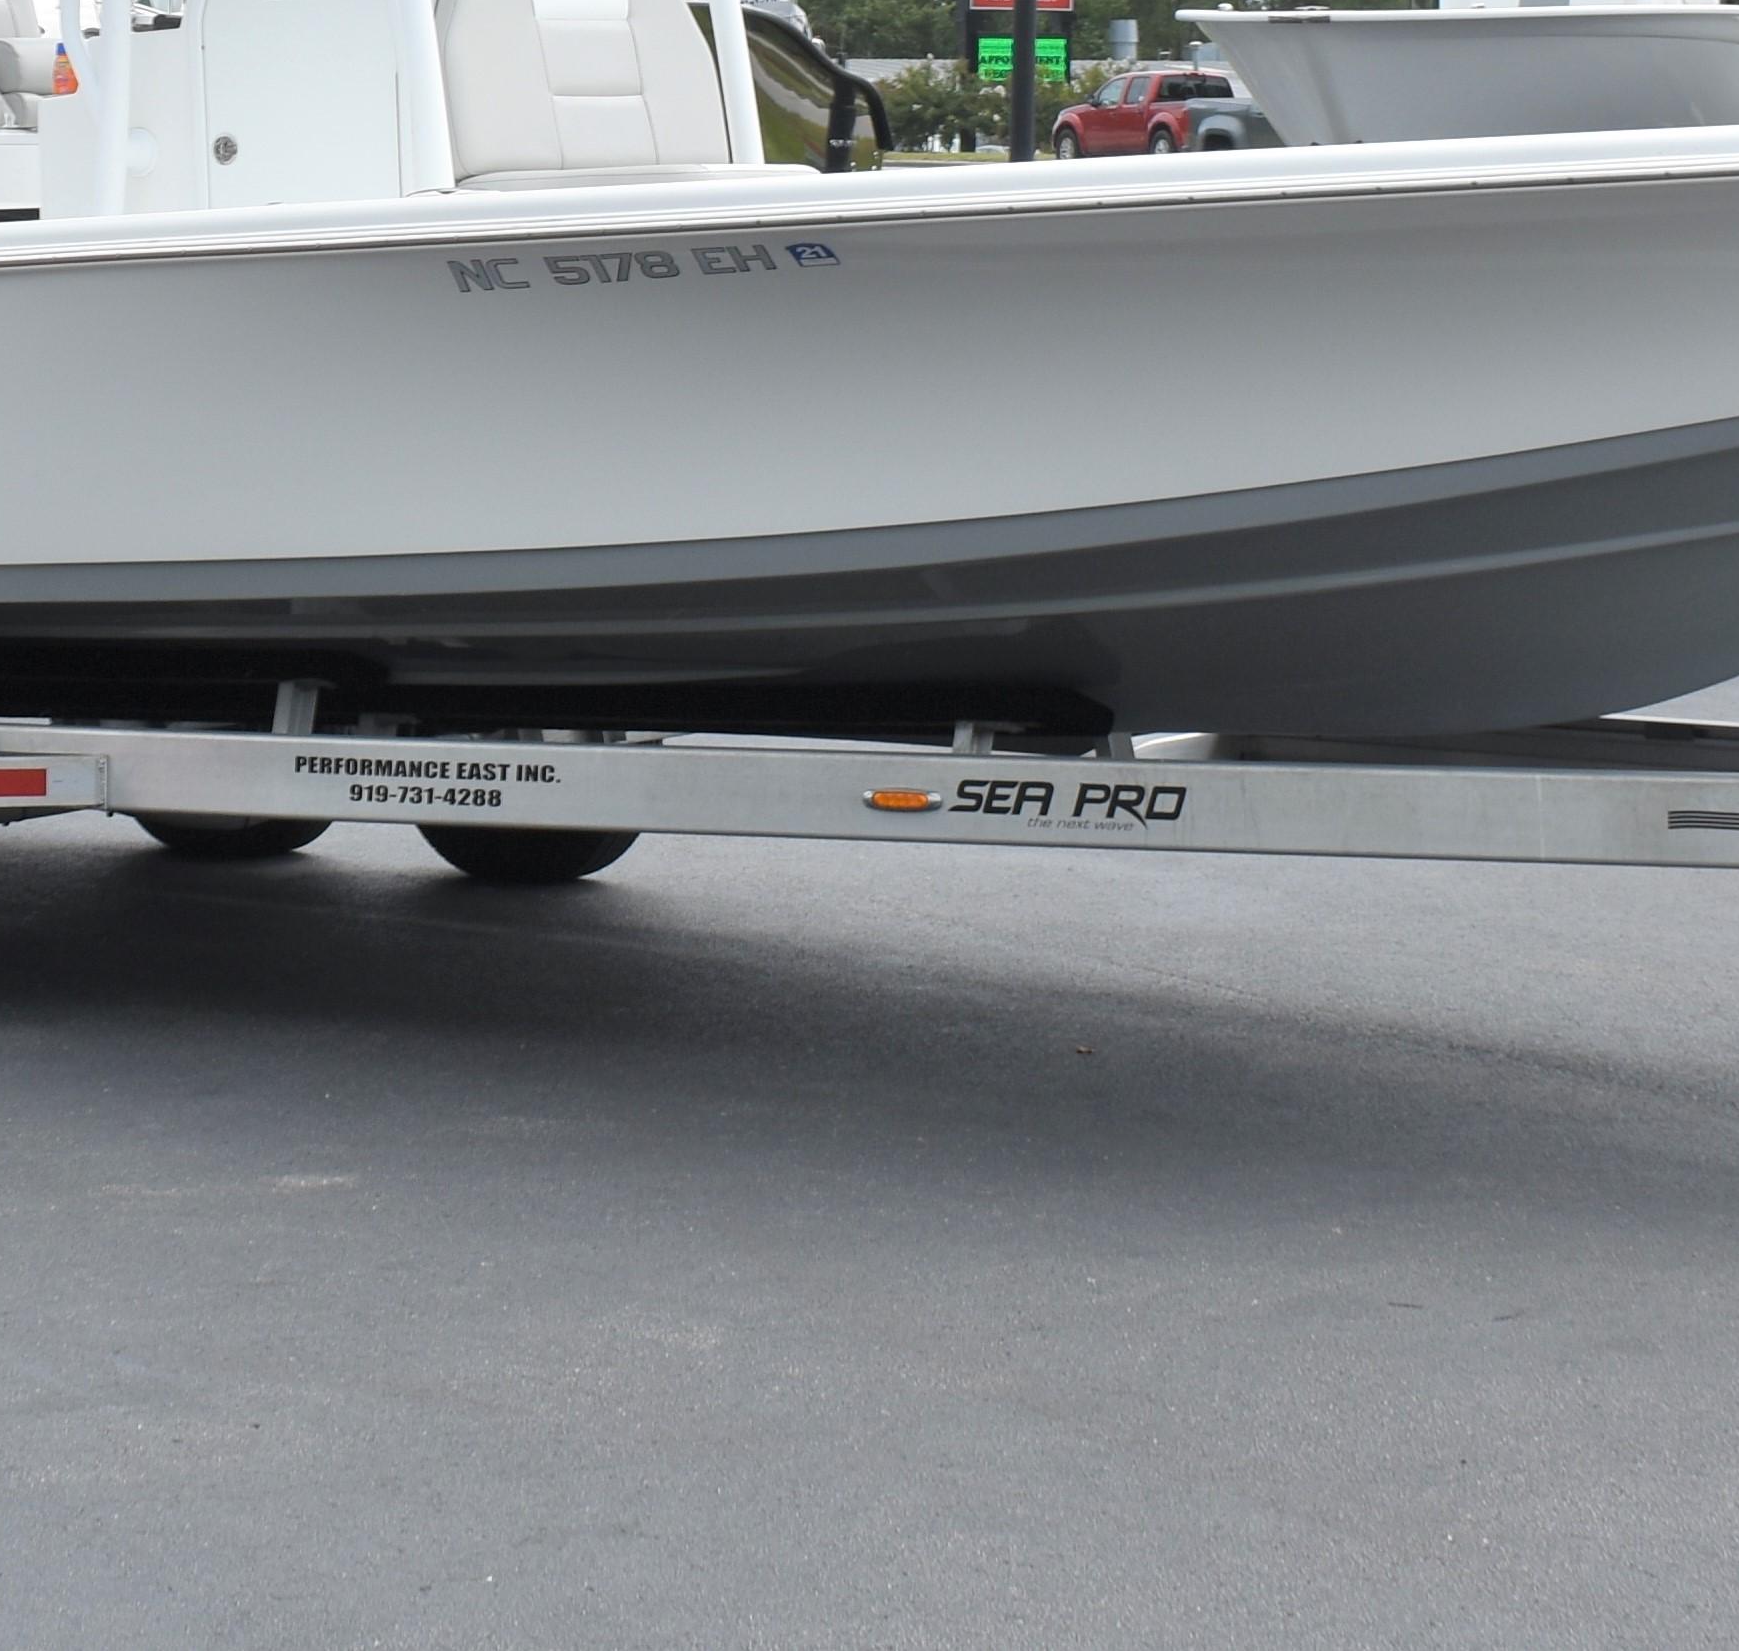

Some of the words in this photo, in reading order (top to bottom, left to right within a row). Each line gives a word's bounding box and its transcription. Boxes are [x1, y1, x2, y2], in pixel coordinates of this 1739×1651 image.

[795, 245, 829, 260] 21
[447, 258, 531, 292] NC
[543, 250, 681, 285] 5178
[691, 244, 776, 274] EH
[295, 755, 450, 780] PERFORMANCE
[456, 762, 510, 781] EAST
[516, 764, 561, 783] INC.
[349, 783, 502, 807] 919-731-4288
[948, 779, 1054, 816] SEA
[1072, 782, 1187, 830] PRO
[1027, 817, 1052, 829] the
[1056, 819, 1090, 830] next
[1094, 821, 1135, 831] wave
